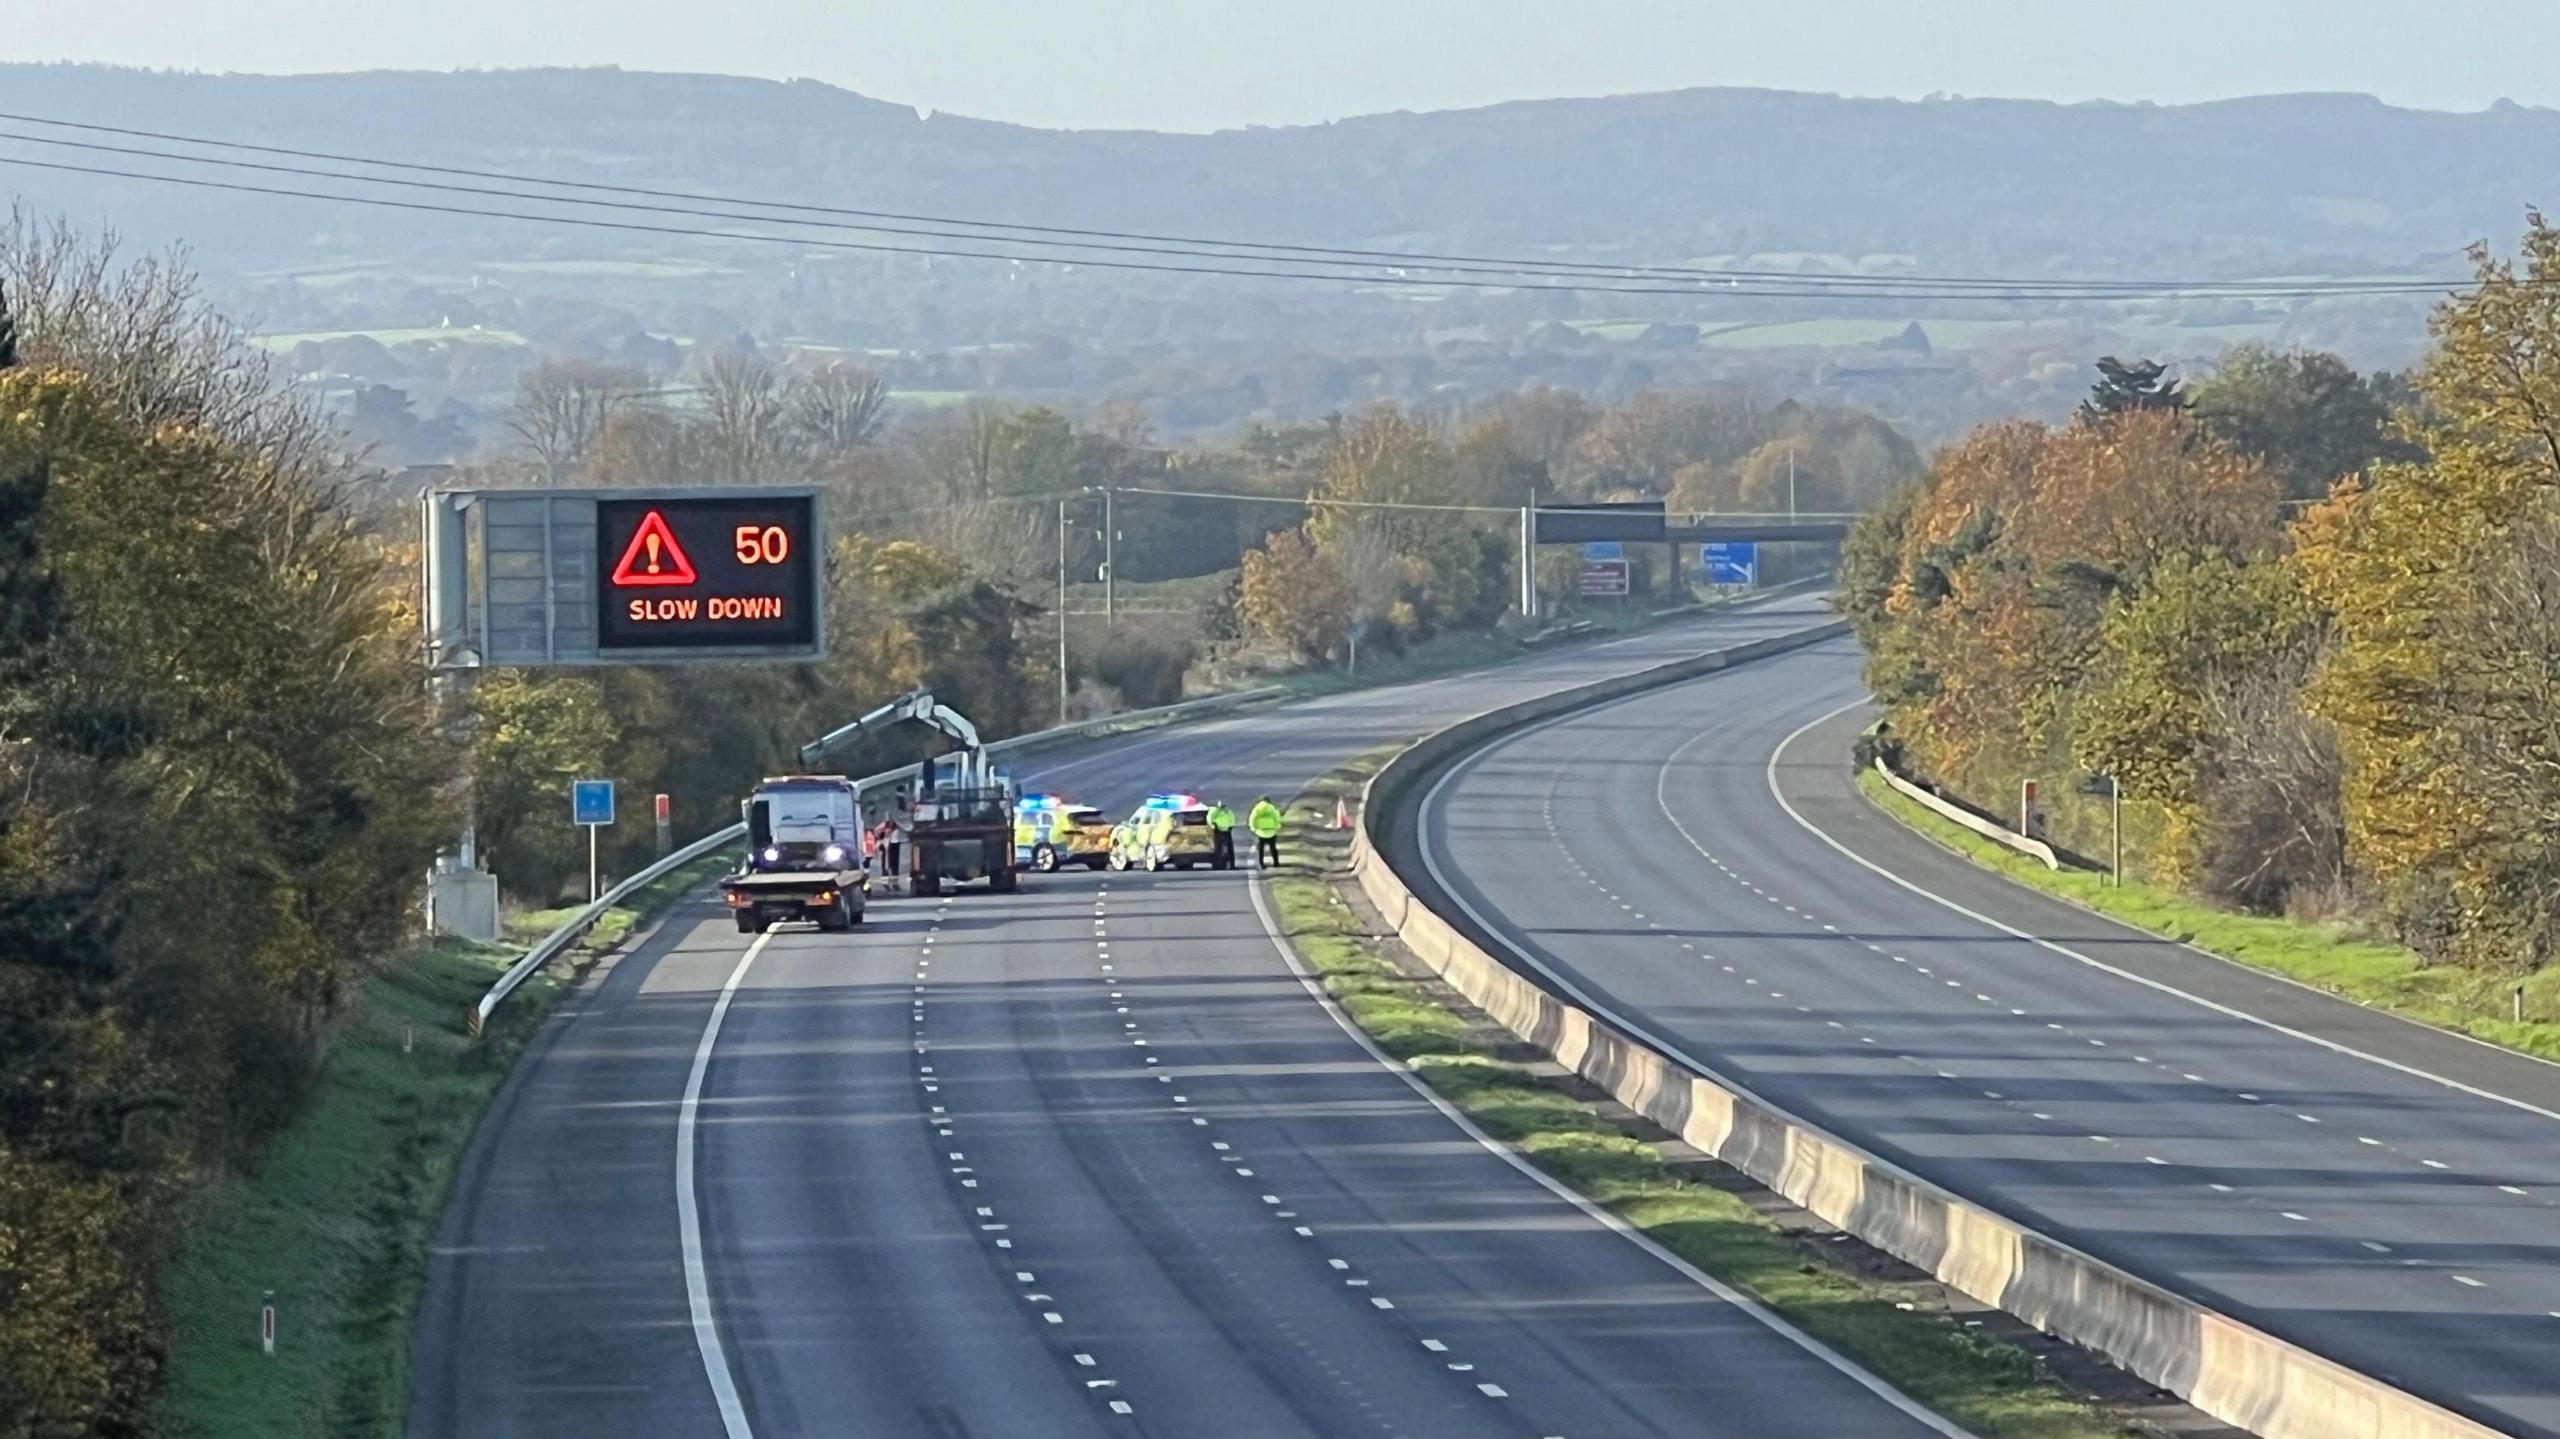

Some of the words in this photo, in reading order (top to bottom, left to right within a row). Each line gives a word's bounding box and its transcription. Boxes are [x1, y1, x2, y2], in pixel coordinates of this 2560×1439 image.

[736, 526, 788, 564] 50
[629, 599, 698, 621] SLOW
[708, 597, 782, 620] DOWN
